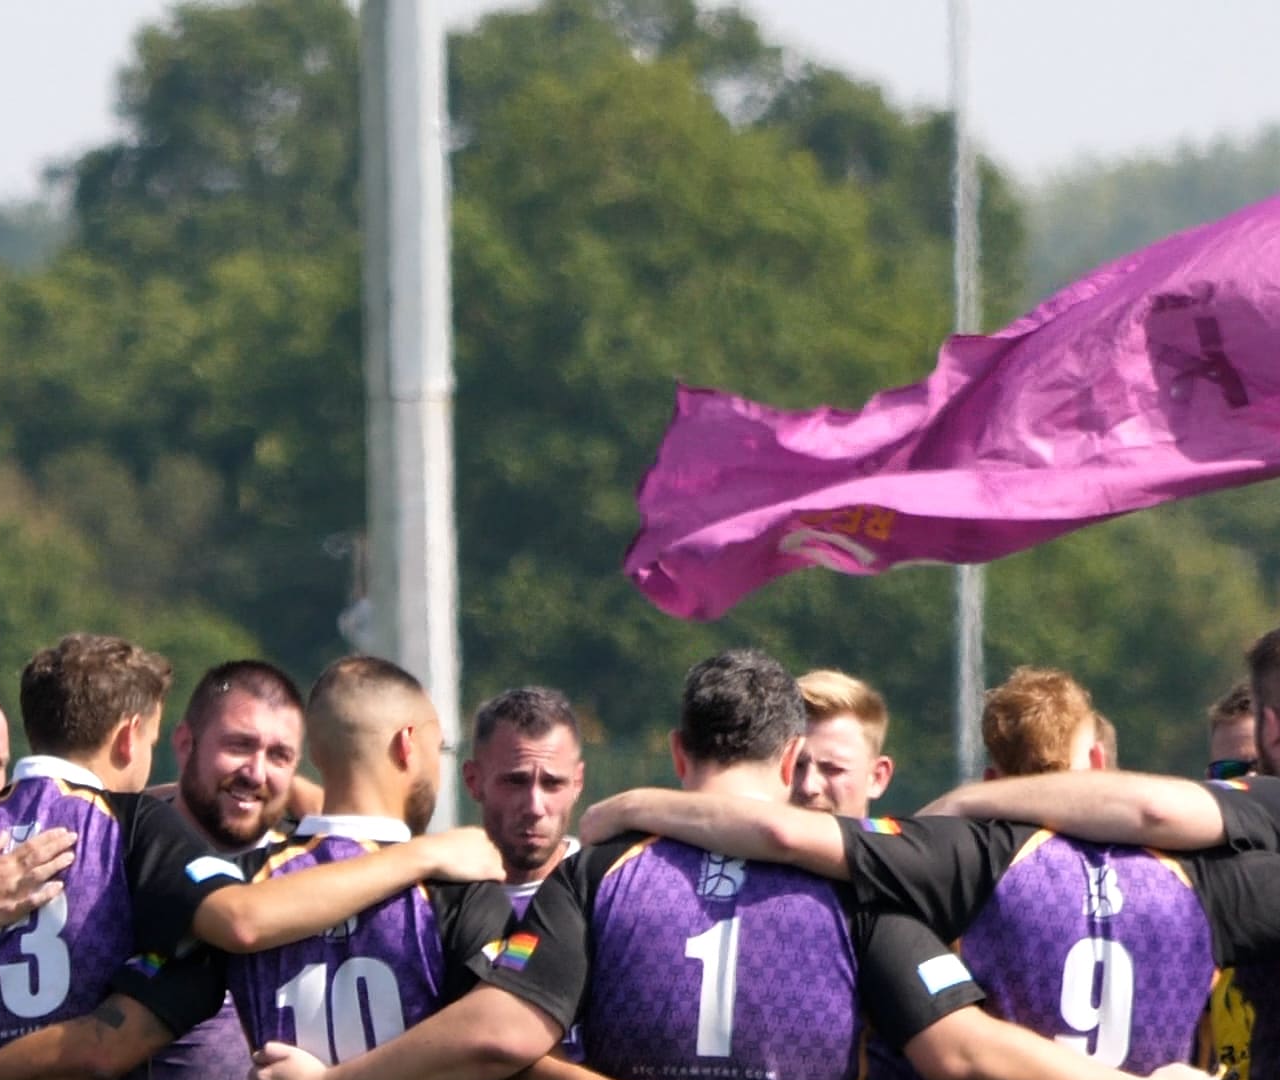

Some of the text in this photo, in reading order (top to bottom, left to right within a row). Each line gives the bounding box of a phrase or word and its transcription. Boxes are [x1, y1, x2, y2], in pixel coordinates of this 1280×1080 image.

[275, 956, 406, 1067] 10
[684, 916, 740, 1058] 1
[1053, 937, 1134, 1069] 9
